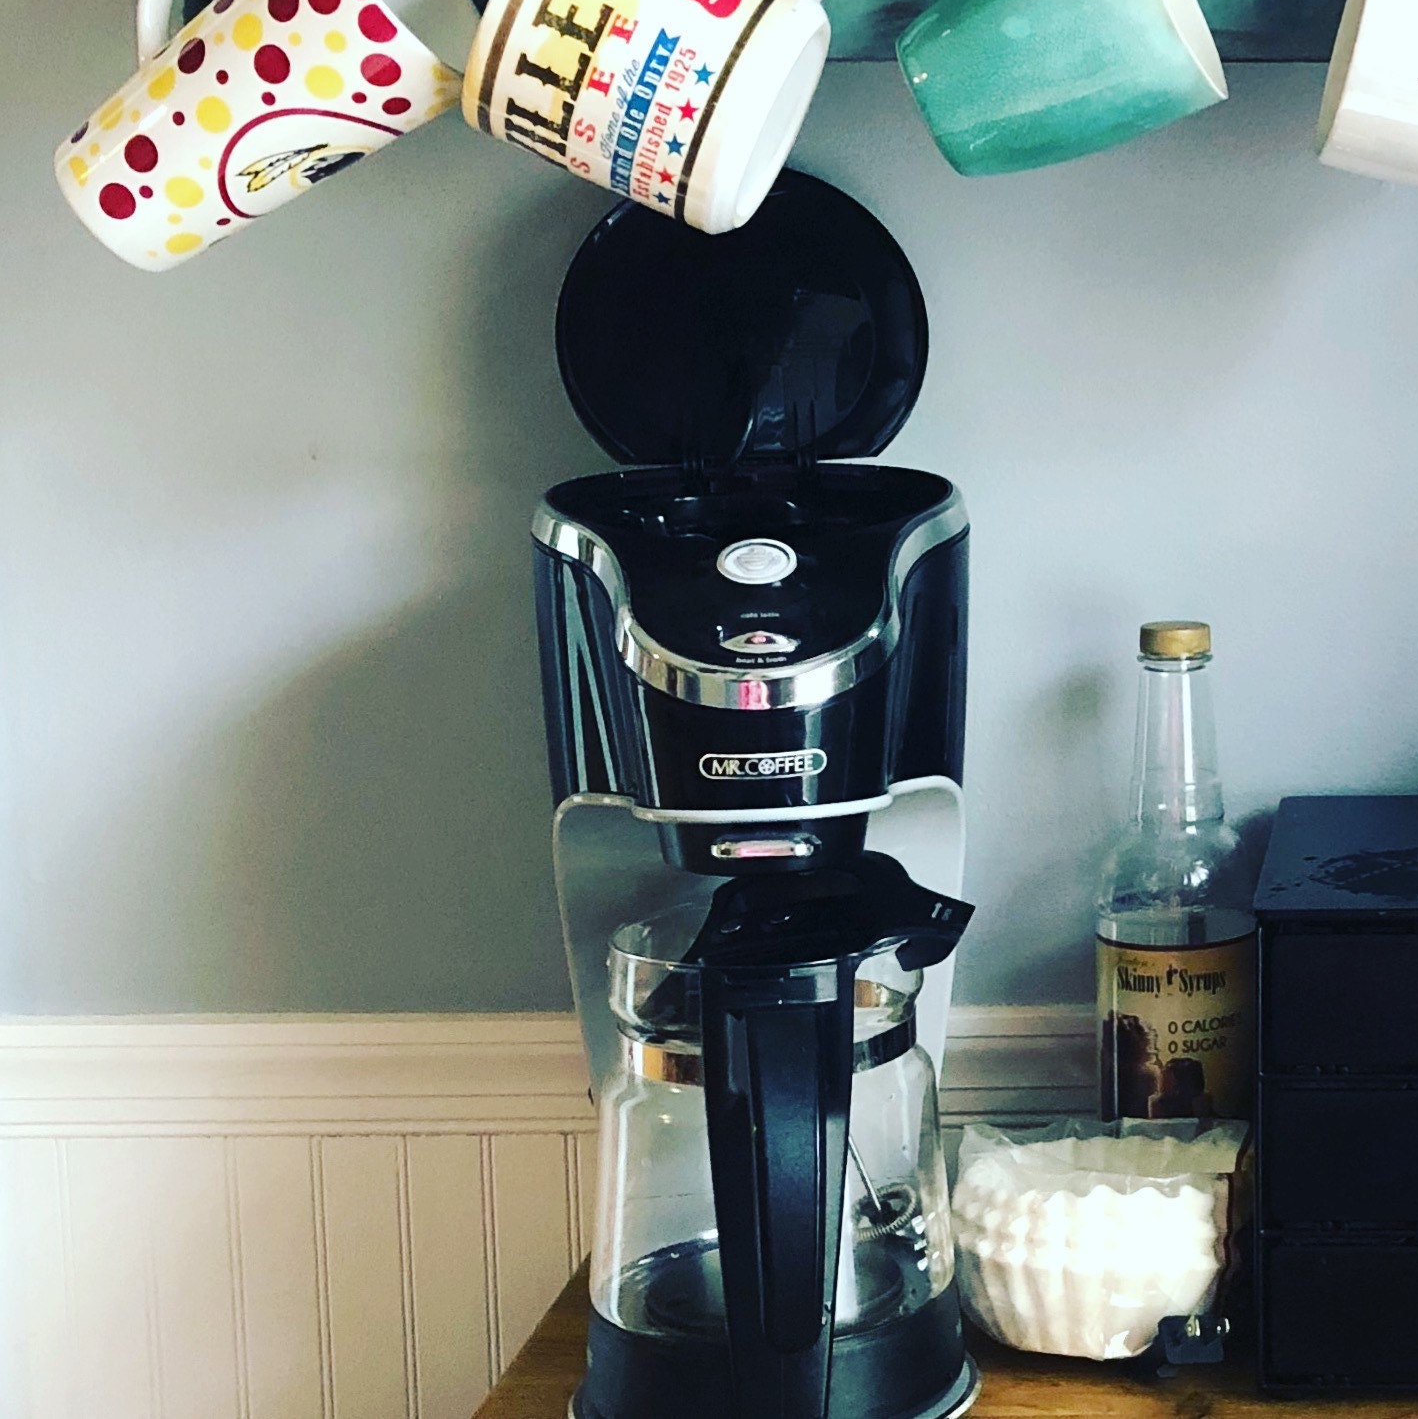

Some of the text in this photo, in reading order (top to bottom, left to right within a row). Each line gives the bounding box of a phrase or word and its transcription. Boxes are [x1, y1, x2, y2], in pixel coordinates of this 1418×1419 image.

[599, 58, 641, 161] Home of the
[620, 108, 645, 141] Ole
[632, 47, 697, 201] Established 1925
[1117, 966, 1226, 998] Skinny Syrups
[1168, 1013, 1240, 1034] 0 CALOR
[1168, 1036, 1227, 1054] 0 SUGAR
